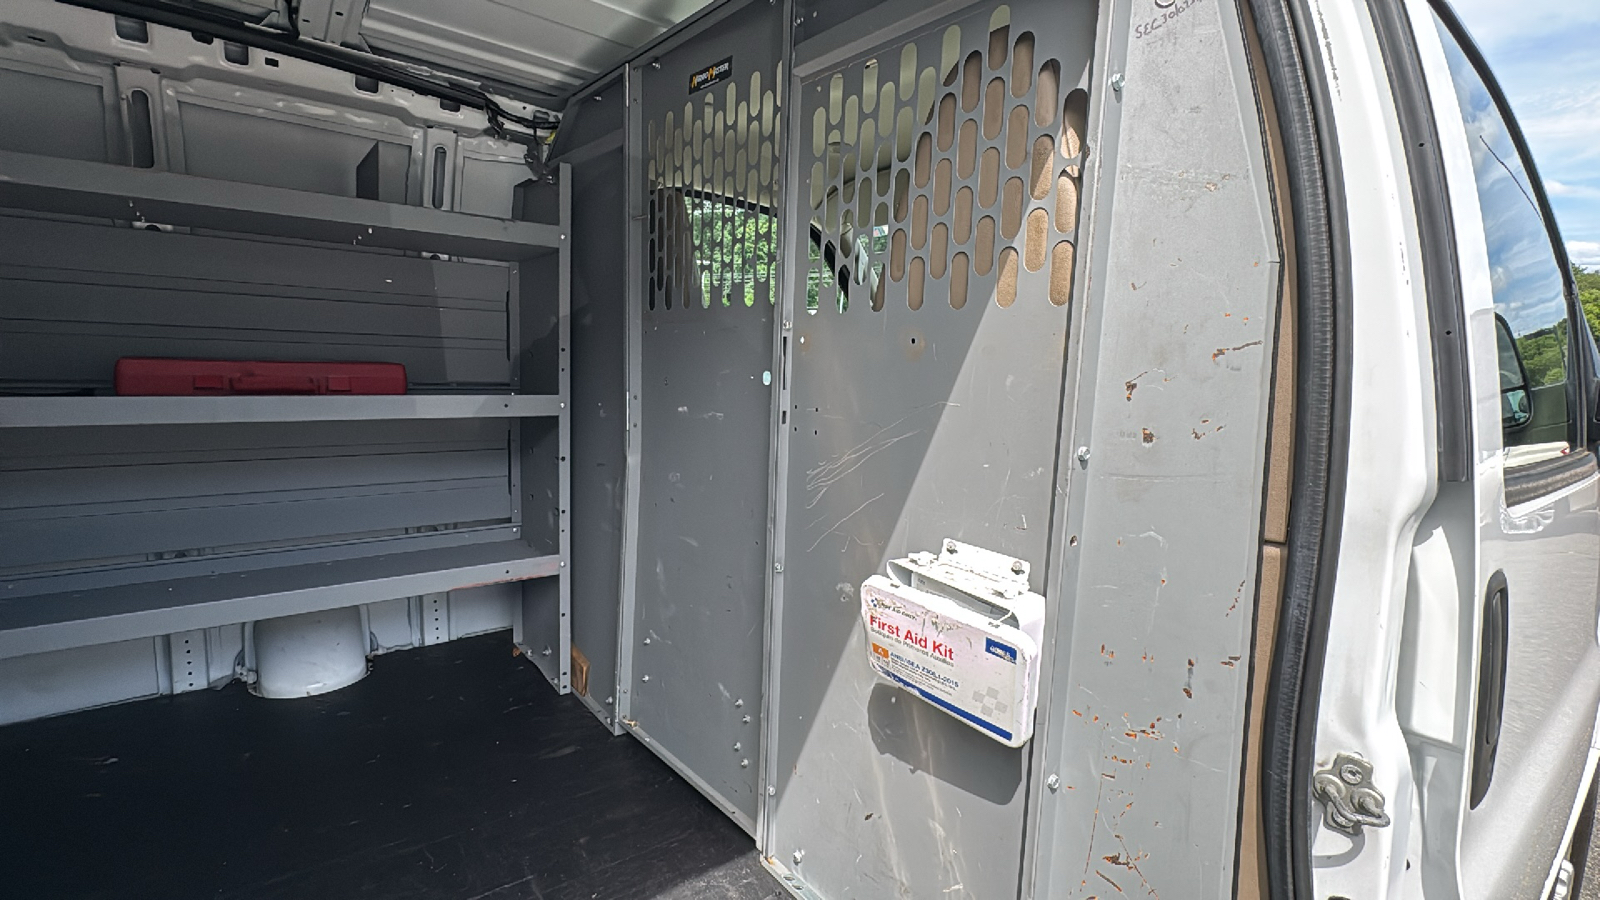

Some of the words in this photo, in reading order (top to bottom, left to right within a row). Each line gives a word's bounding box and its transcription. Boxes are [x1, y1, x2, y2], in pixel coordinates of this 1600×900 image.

[869, 614, 901, 638] First
[904, 630, 927, 649] Aid
[932, 640, 954, 661] Kit
